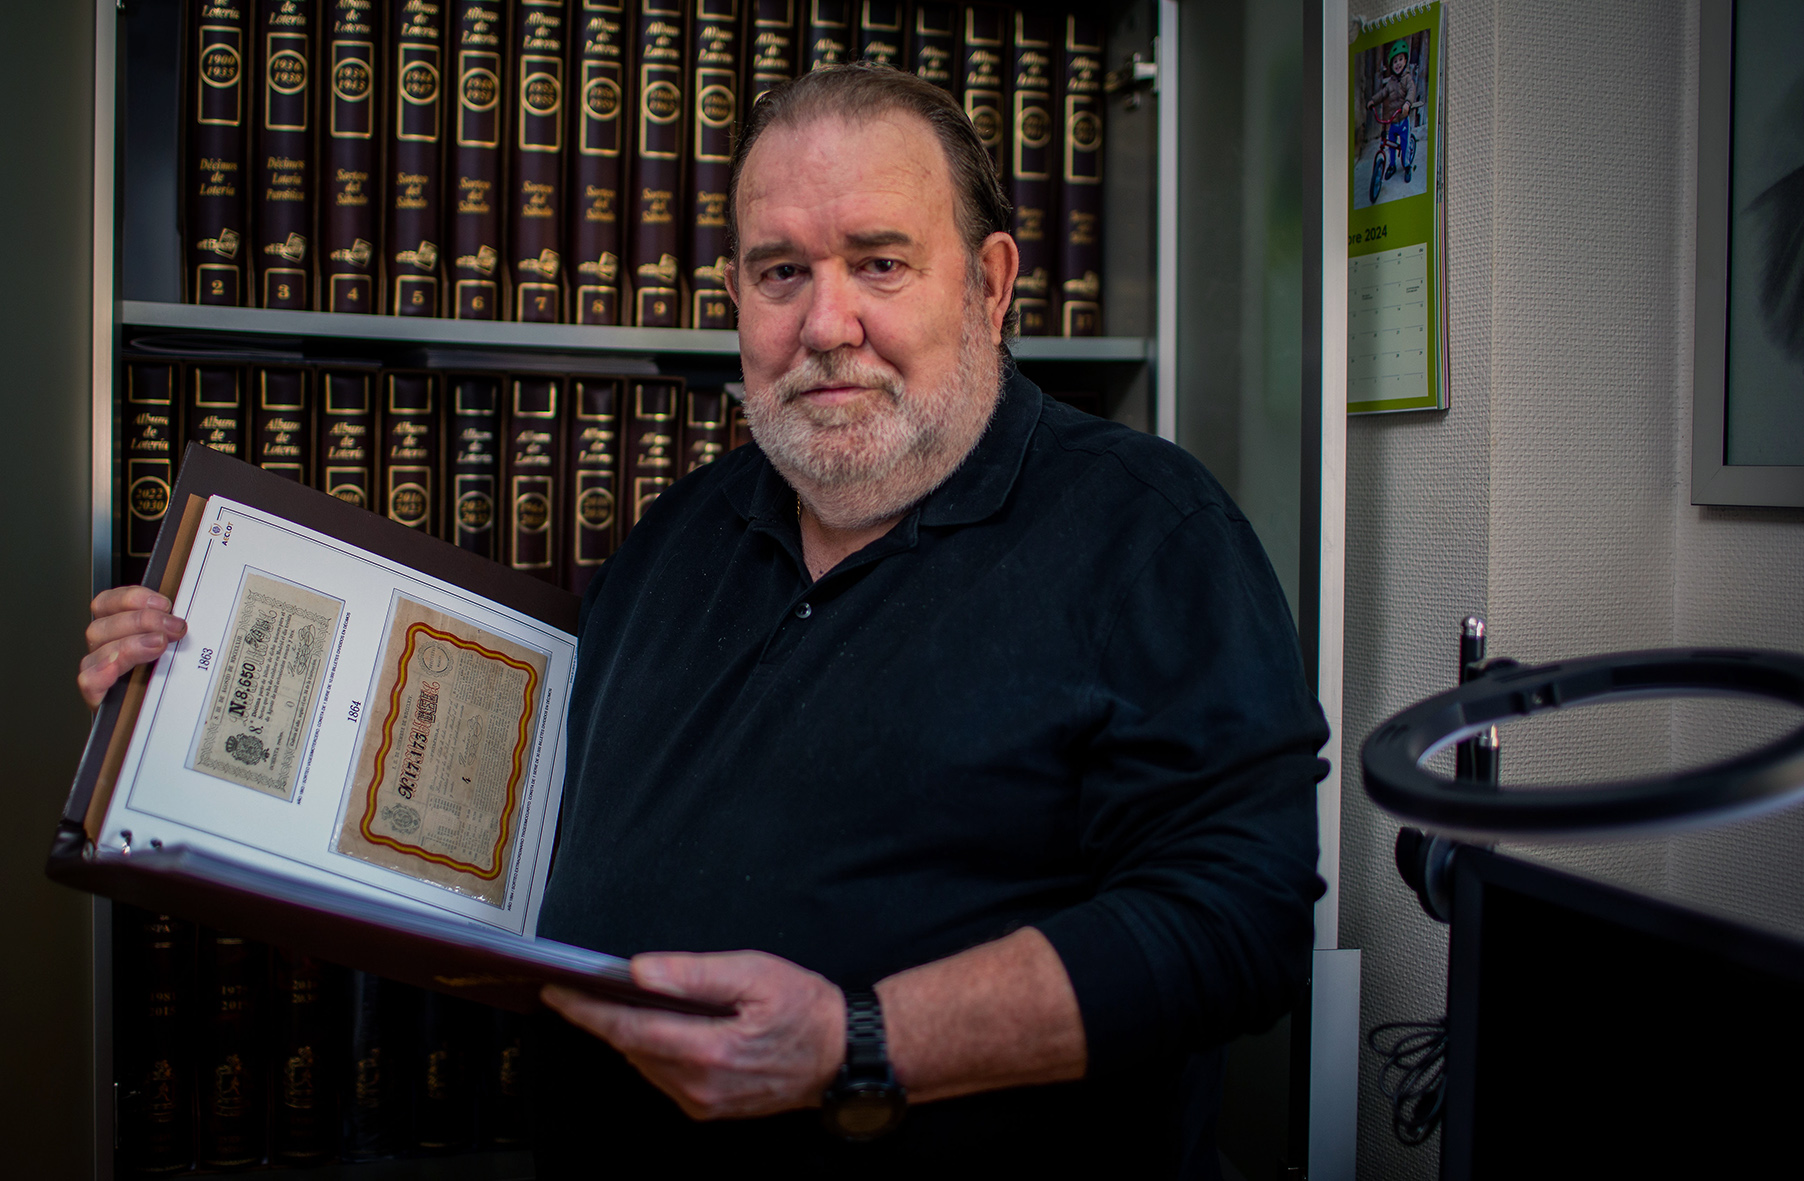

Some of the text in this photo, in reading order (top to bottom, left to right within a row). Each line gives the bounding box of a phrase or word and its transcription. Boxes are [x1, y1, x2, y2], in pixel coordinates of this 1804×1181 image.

[280, 0, 297, 14] de
[208, 54, 236, 66] 1900
[274, 59, 302, 72] 1936
[207, 66, 235, 79] 1935
[200, 158, 238, 171] Décimos
[267, 156, 305, 170] Décimos
[210, 171, 225, 183] de
[272, 172, 303, 186] Lotería
[199, 182, 235, 197] Lotería
[1365, 224, 1388, 242] 2024
[211, 279, 225, 296] 2
[277, 284, 291, 300] 3
[347, 288, 359, 301] 4
[412, 290, 425, 305] 5
[471, 296, 484, 311] 6
[534, 296, 548, 311] 7
[592, 299, 605, 314] 8
[653, 301, 667, 316] 9
[705, 302, 726, 318] 10
[132, 412, 169, 426] Album
[198, 415, 238, 430] Album
[264, 418, 301, 432] Album
[142, 425, 158, 439] de
[210, 428, 226, 442] de
[328, 422, 367, 436] Album
[275, 431, 291, 444] de
[340, 435, 356, 448] de
[402, 434, 418, 447] de
[135, 488, 163, 500] 2022
[220, 521, 234, 545] AECLOT
[198, 647, 213, 670] 1863
[227, 661, 256, 717] N.8.650
[348, 700, 361, 722] 1864
